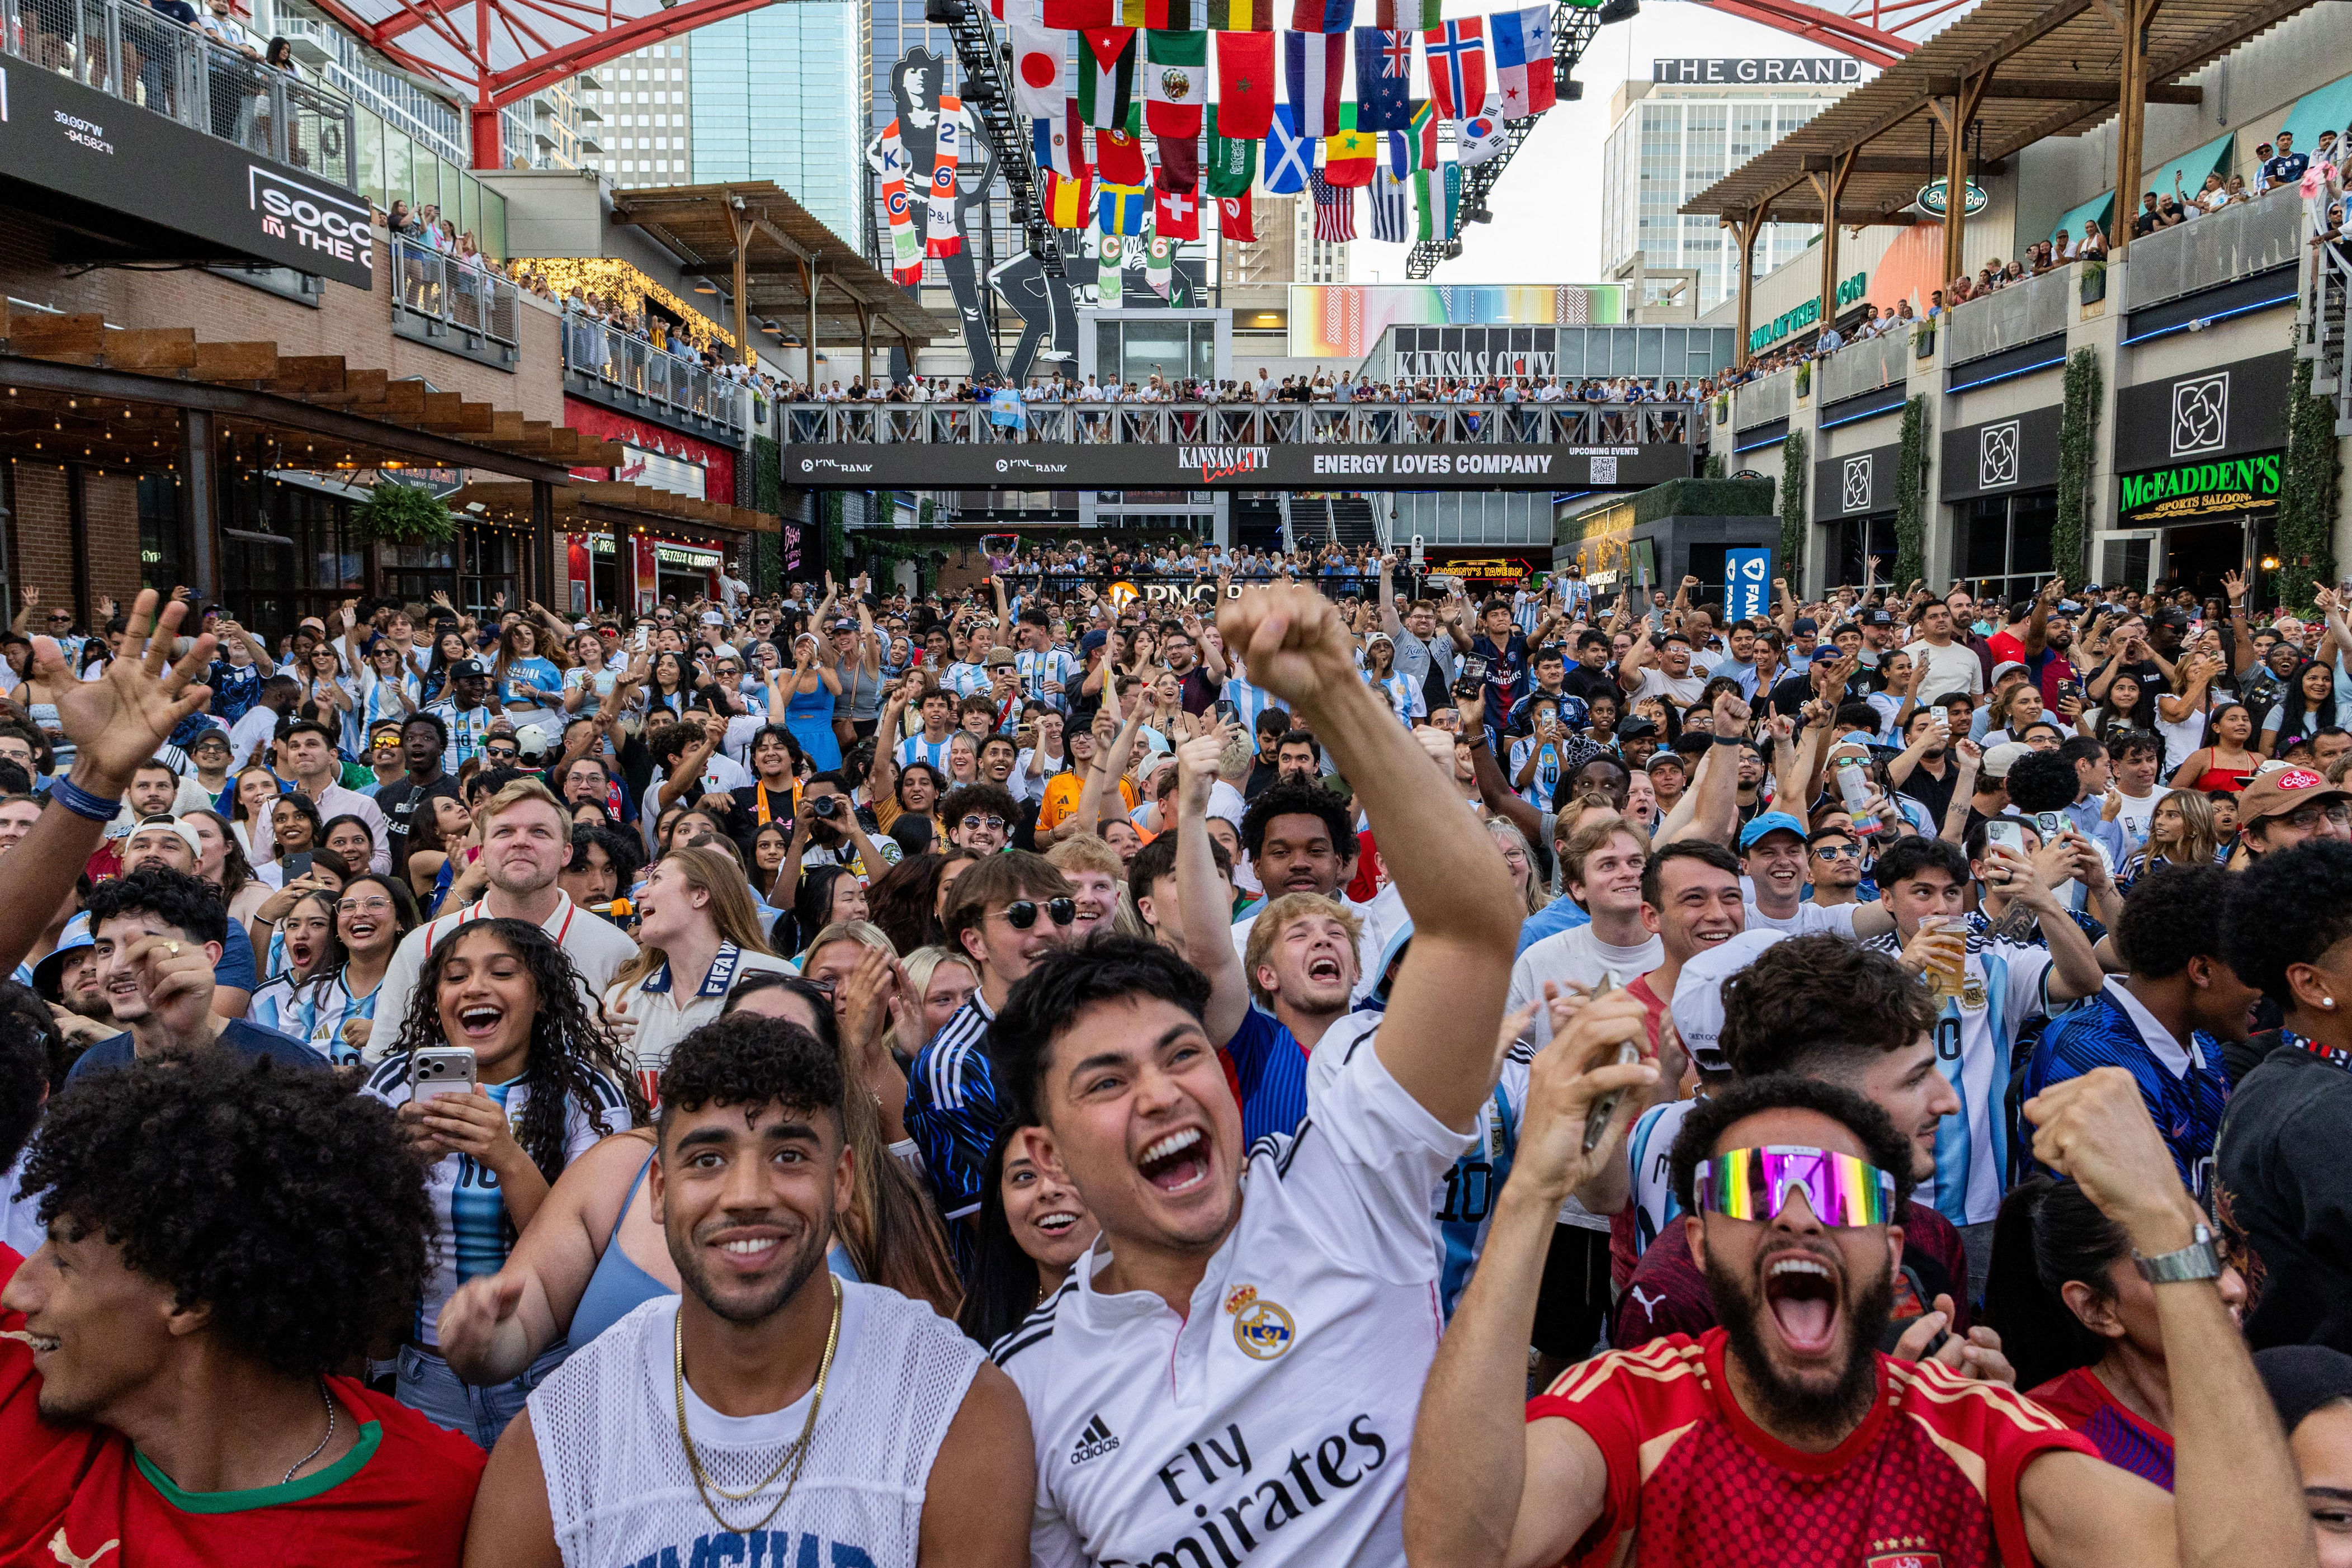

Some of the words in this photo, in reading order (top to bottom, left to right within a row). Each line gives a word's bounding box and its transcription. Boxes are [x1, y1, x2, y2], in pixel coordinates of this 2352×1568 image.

[1654, 59, 1724, 81] THE
[1736, 59, 1861, 81] GRAND
[939, 122, 955, 143] 2
[884, 148, 899, 171] K
[934, 166, 953, 187] 6
[889, 191, 908, 215] C
[1965, 191, 1985, 206] Bar
[291, 224, 355, 262] THE
[1101, 235, 1120, 258] C
[1150, 235, 1168, 258] 6
[1395, 351, 1490, 387] KANSAS
[1178, 447, 1234, 468] KANSAS
[1236, 447, 1271, 468] CITY
[1202, 452, 1254, 483] Live!
[1314, 455, 1388, 474] ENERGY
[1393, 455, 1451, 474] LOVES
[1456, 455, 1552, 474] COMPANY
[659, 549, 687, 563] PRETZELS
[1432, 567, 1481, 576] JOHNNY'S
[1484, 567, 1522, 577] TAVERN
[1144, 585, 1216, 606] PNC
[1486, 670, 1522, 685] Emirates
[1542, 767, 1557, 783] 10
[2283, 776, 2317, 786] Coors
[706, 957, 735, 993] FIFA
[1435, 1163, 1493, 1223] 10
[1070, 1434, 1120, 1465] adidas
[1158, 1423, 1253, 1506] Fly
[1099, 1413, 1387, 1568] mirates
